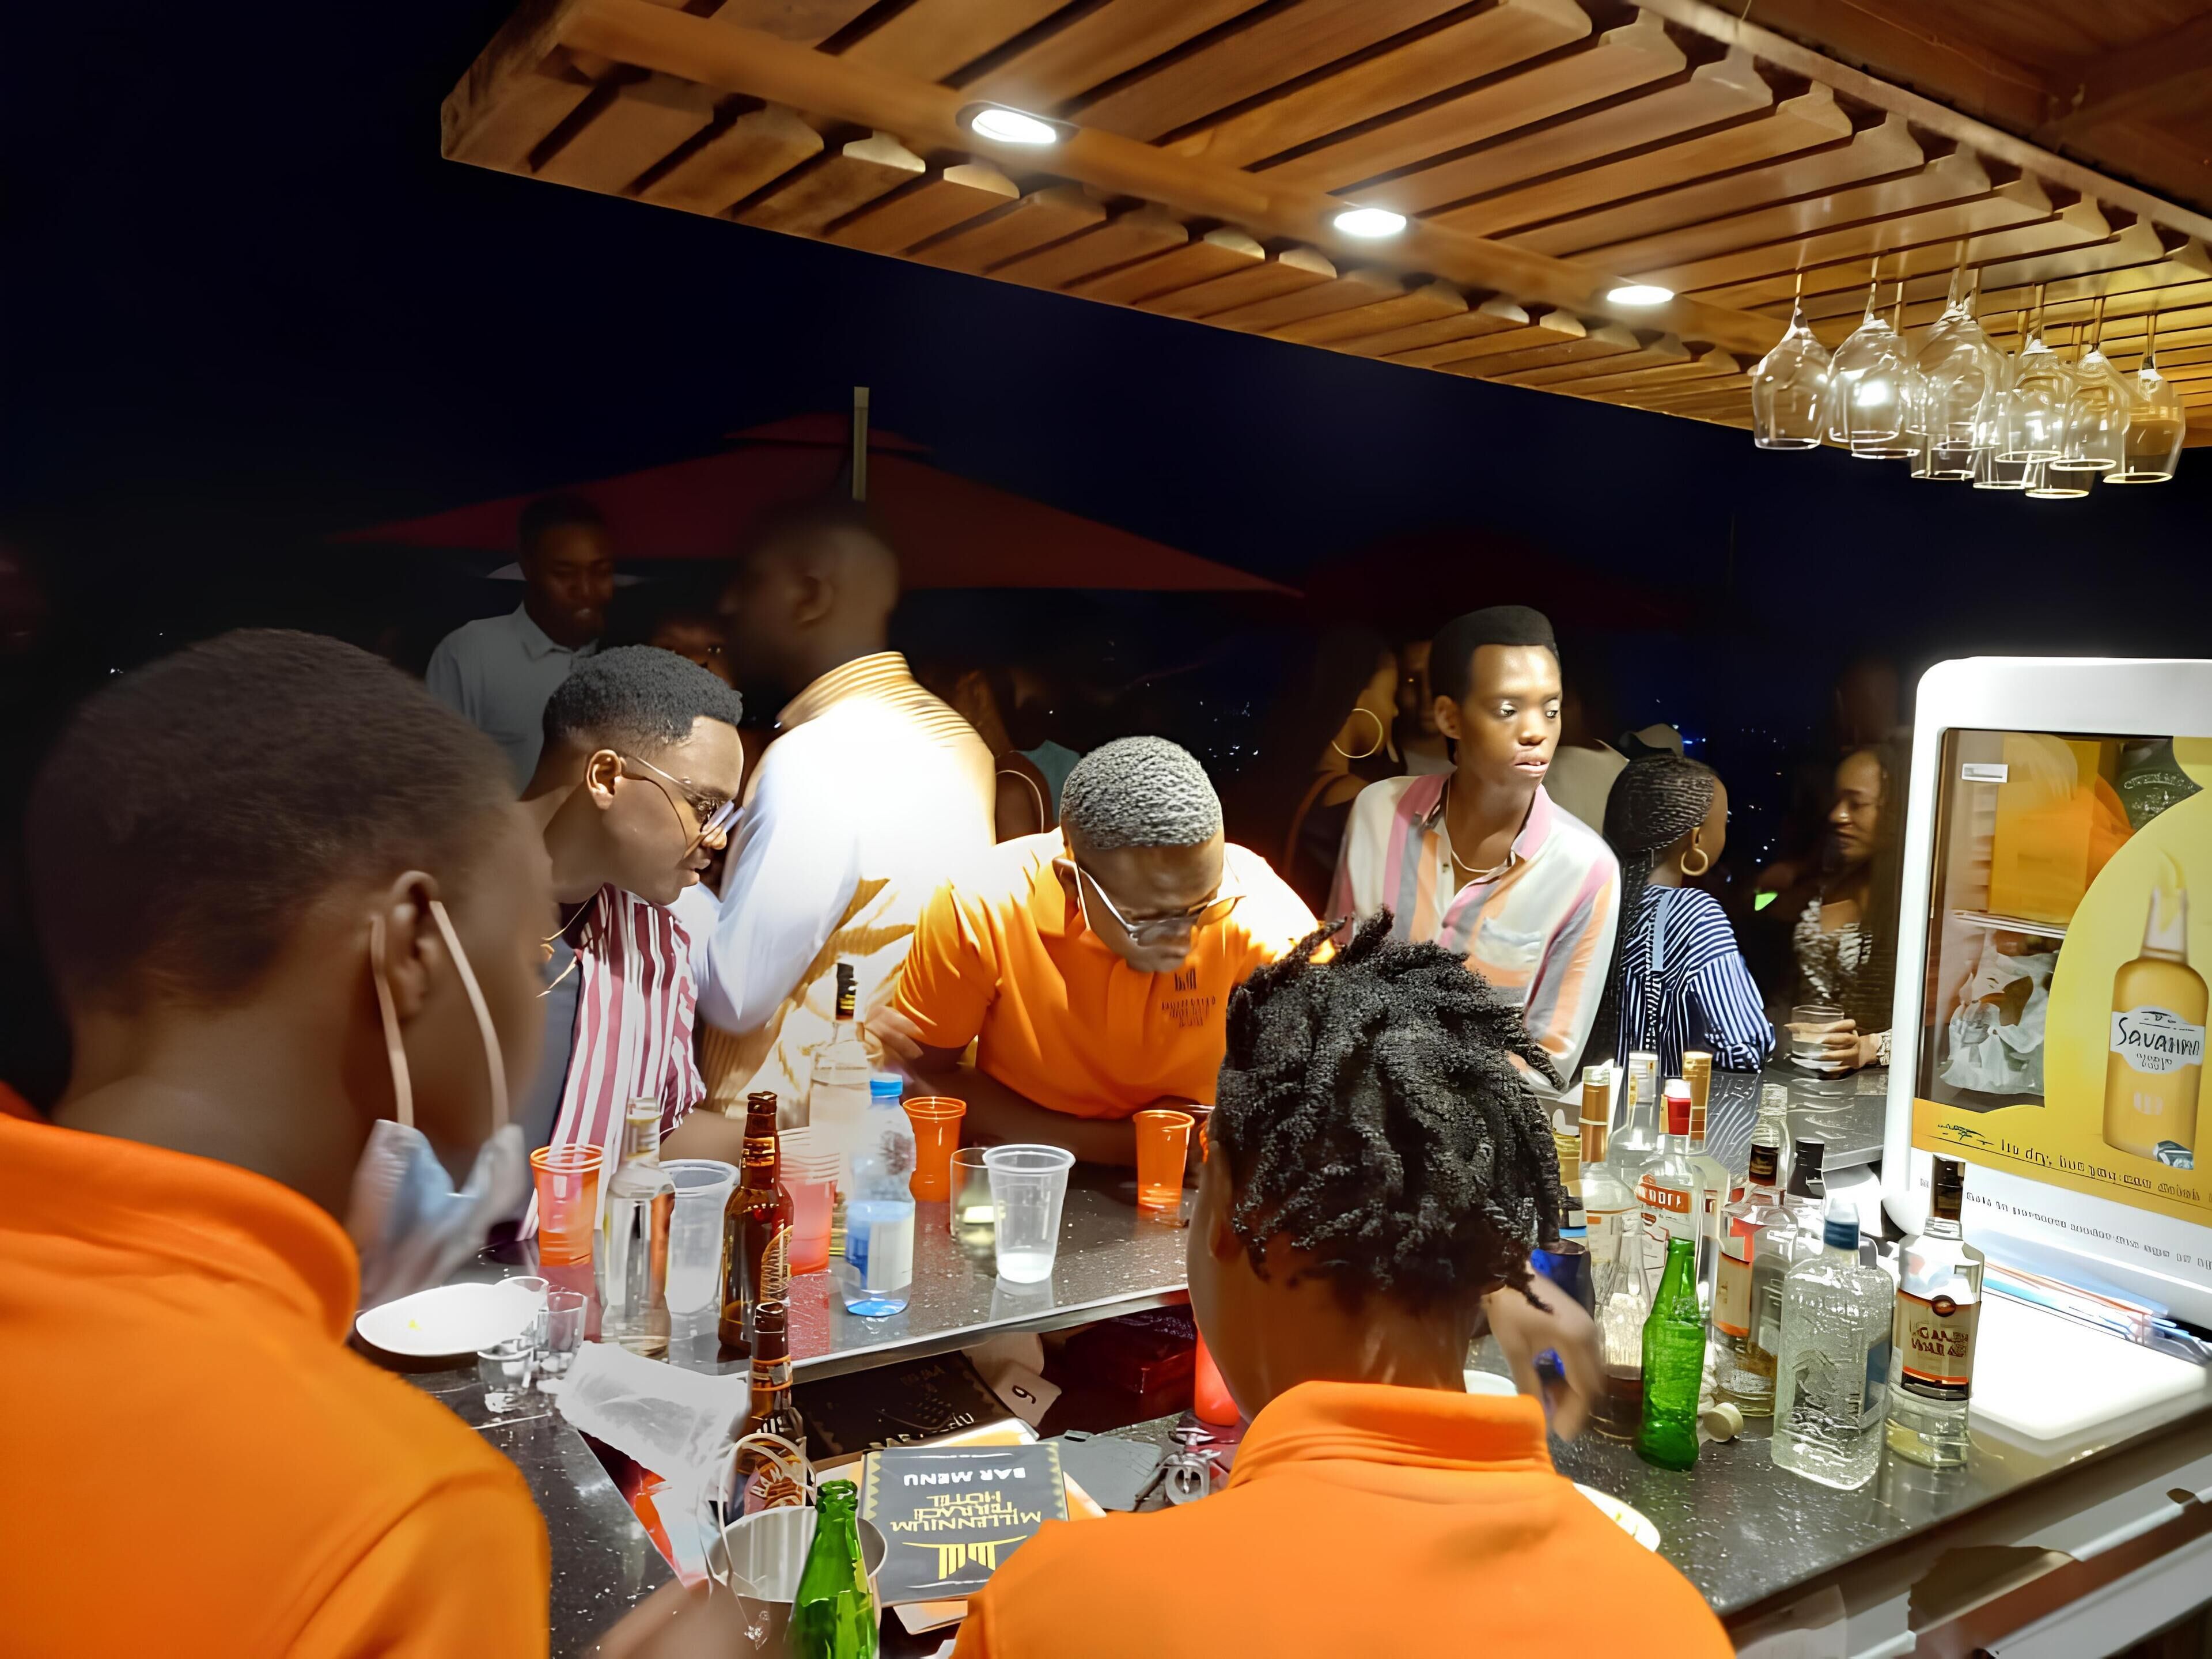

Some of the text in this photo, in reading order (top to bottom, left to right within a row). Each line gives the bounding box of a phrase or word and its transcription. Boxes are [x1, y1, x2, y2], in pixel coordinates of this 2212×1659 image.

[903, 1467, 1026, 1486] BAR MENU
[890, 1508, 1041, 1532] MILLENNIUM
